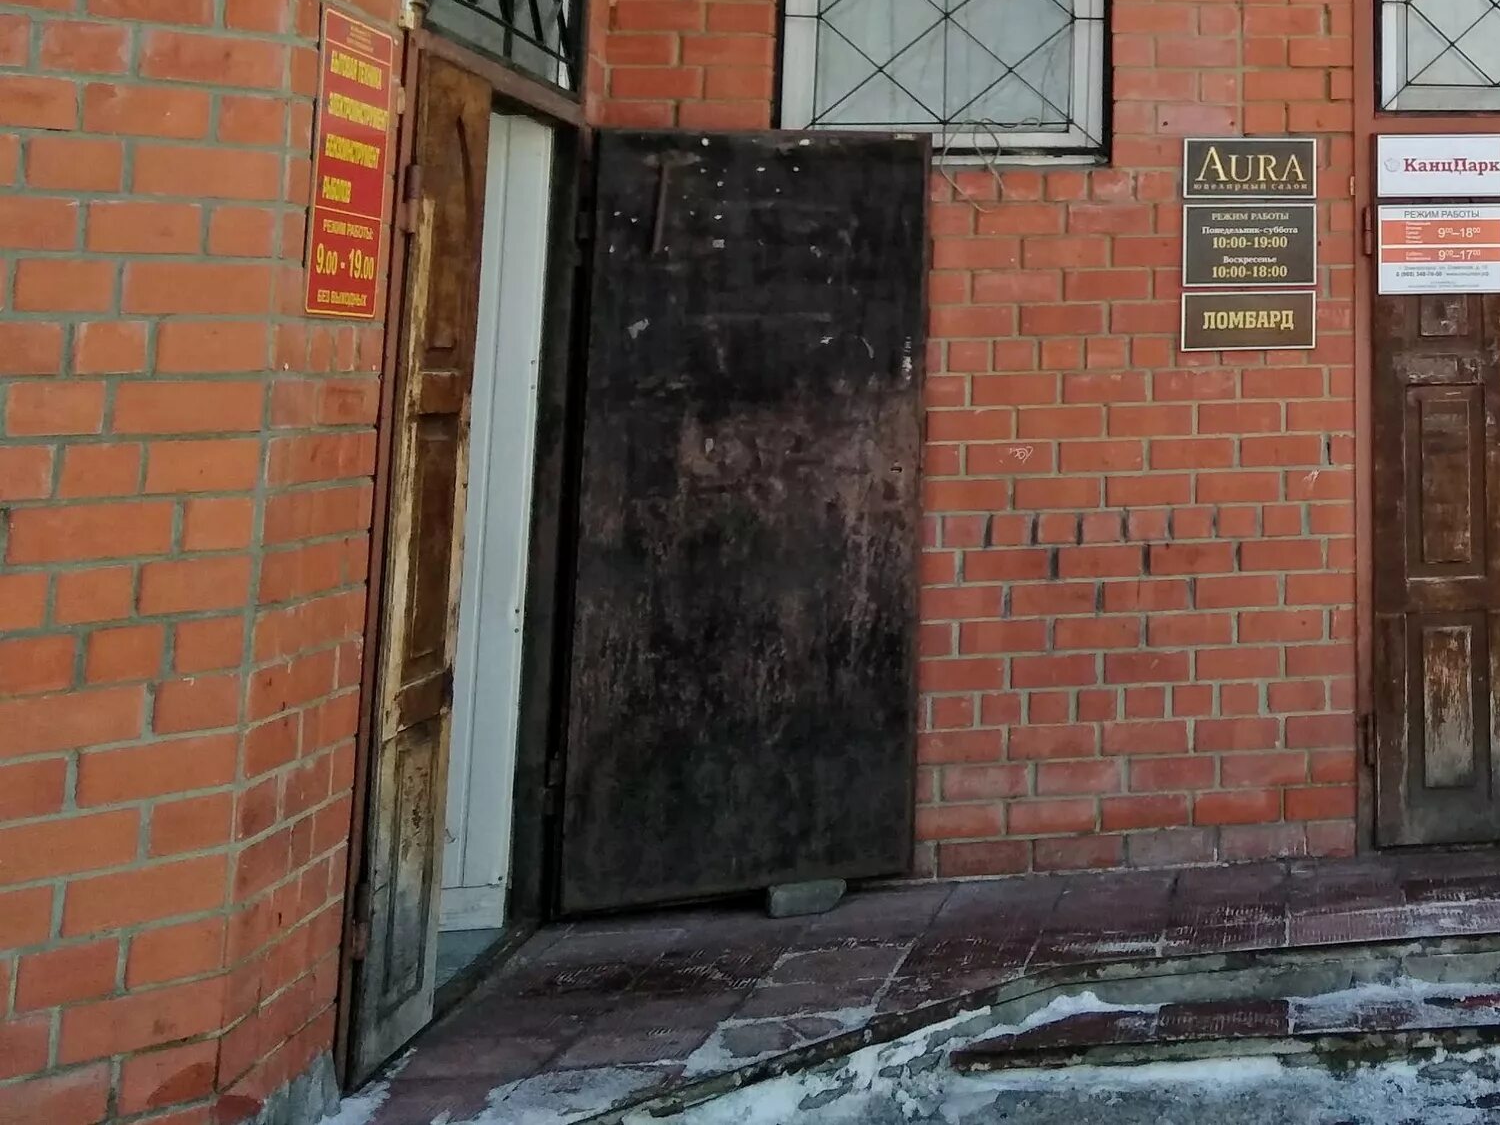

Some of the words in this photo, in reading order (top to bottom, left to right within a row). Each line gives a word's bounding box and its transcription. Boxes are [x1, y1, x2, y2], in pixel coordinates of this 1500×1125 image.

[1403, 157, 1500, 176] КанцПарк
[1193, 183, 1266, 192] ювелирный
[1271, 183, 1308, 191] салон
[1211, 213, 1248, 221] РЕЖИМ
[1251, 212, 1289, 220] РАБОТЫ
[1403, 210, 1439, 219] РЕЖИМ
[1442, 210, 1480, 218] РАБОТЫ
[322, 219, 346, 236] РЕЖИМ
[1202, 226, 1298, 235] Понедельник-суббота
[1212, 236, 1288, 249] 10:00-19:00
[316, 243, 338, 276] 9.00
[349, 248, 375, 280] 19.00
[1223, 256, 1277, 265] Воскресенье
[1212, 266, 1288, 279] 10:00-18:00
[317, 289, 330, 304] БЕЗ
[331, 290, 367, 308] ВЫХОДНЫХ
[1202, 310, 1295, 331] ЛОМБАРД
